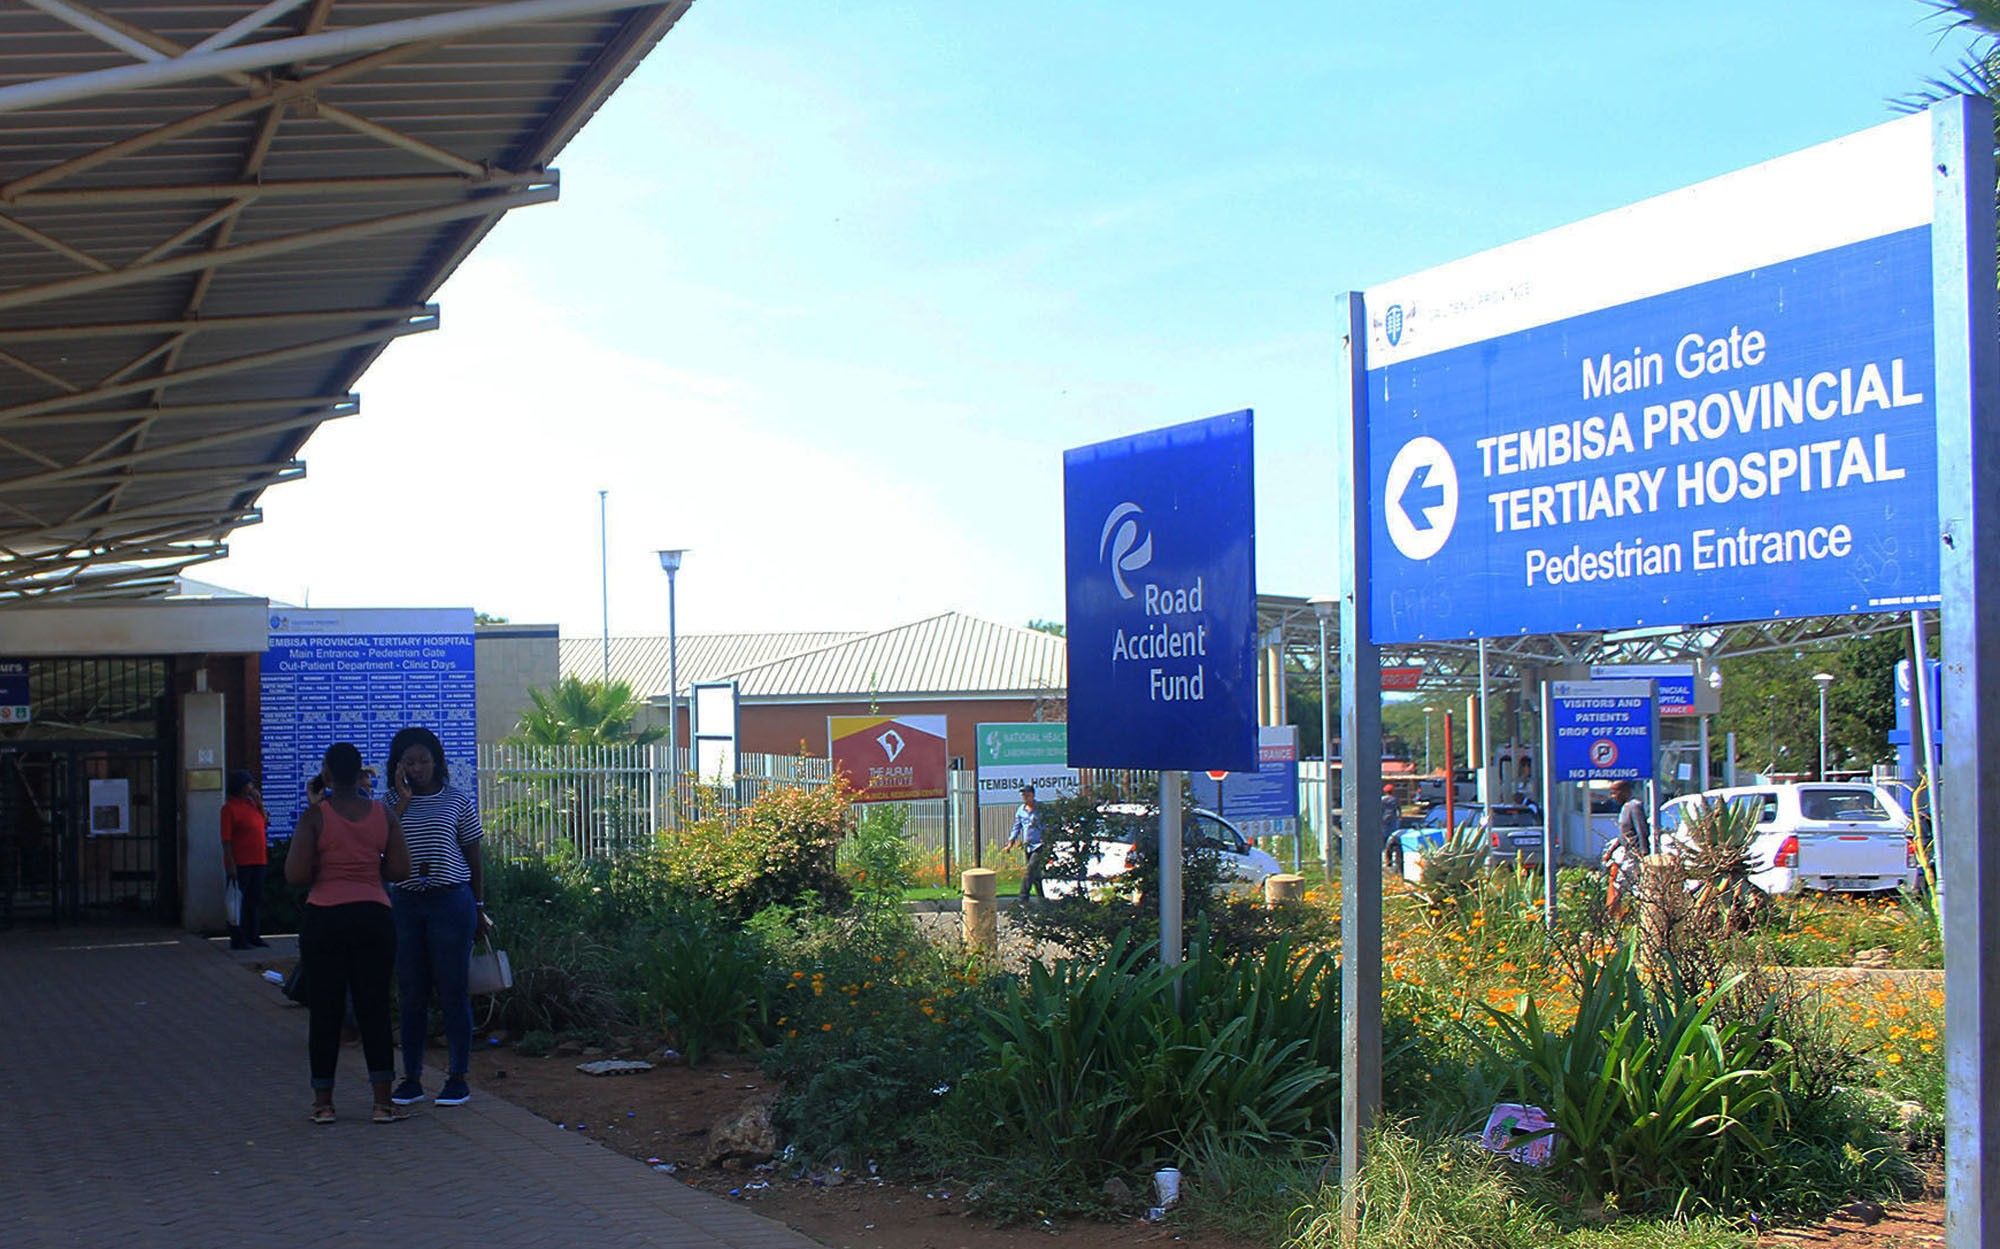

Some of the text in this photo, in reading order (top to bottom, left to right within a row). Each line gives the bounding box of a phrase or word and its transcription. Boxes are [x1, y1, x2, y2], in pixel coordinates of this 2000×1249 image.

[1582, 325, 1766, 400] Main Gate
[1477, 358, 1923, 477] TEMBISA PROVINCIAL
[1488, 433, 1905, 533] TERTIARY HOSPITAL
[1526, 540, 1682, 587] Pedestrian
[1693, 523, 1852, 569] Entrance
[1145, 576, 1202, 616] Road
[268, 637, 472, 647] EMBISA PROVINCIAL TERTIARY HOSPITAL
[1112, 623, 1206, 661] Accident
[289, 649, 313, 659] Main
[316, 649, 359, 658] Entrance
[368, 648, 420, 657] Pedestrian
[422, 648, 446, 657] Gate
[0, 663, 23, 672] urs
[279, 661, 334, 671] Out-Patient
[337, 660, 394, 672] Department
[402, 659, 430, 669] Clinic
[431, 659, 456, 671] Days
[1150, 664, 1204, 701] Fund
[1562, 699, 1642, 708] VISITORS AND
[1575, 713, 1630, 722] PATIENTS
[1558, 726, 1647, 736] DROP OFF ZONE
[868, 767, 884, 777] THE
[1568, 769, 1639, 778] NO PARKING
[979, 776, 1079, 790] TEMBISA HOSPITAL
